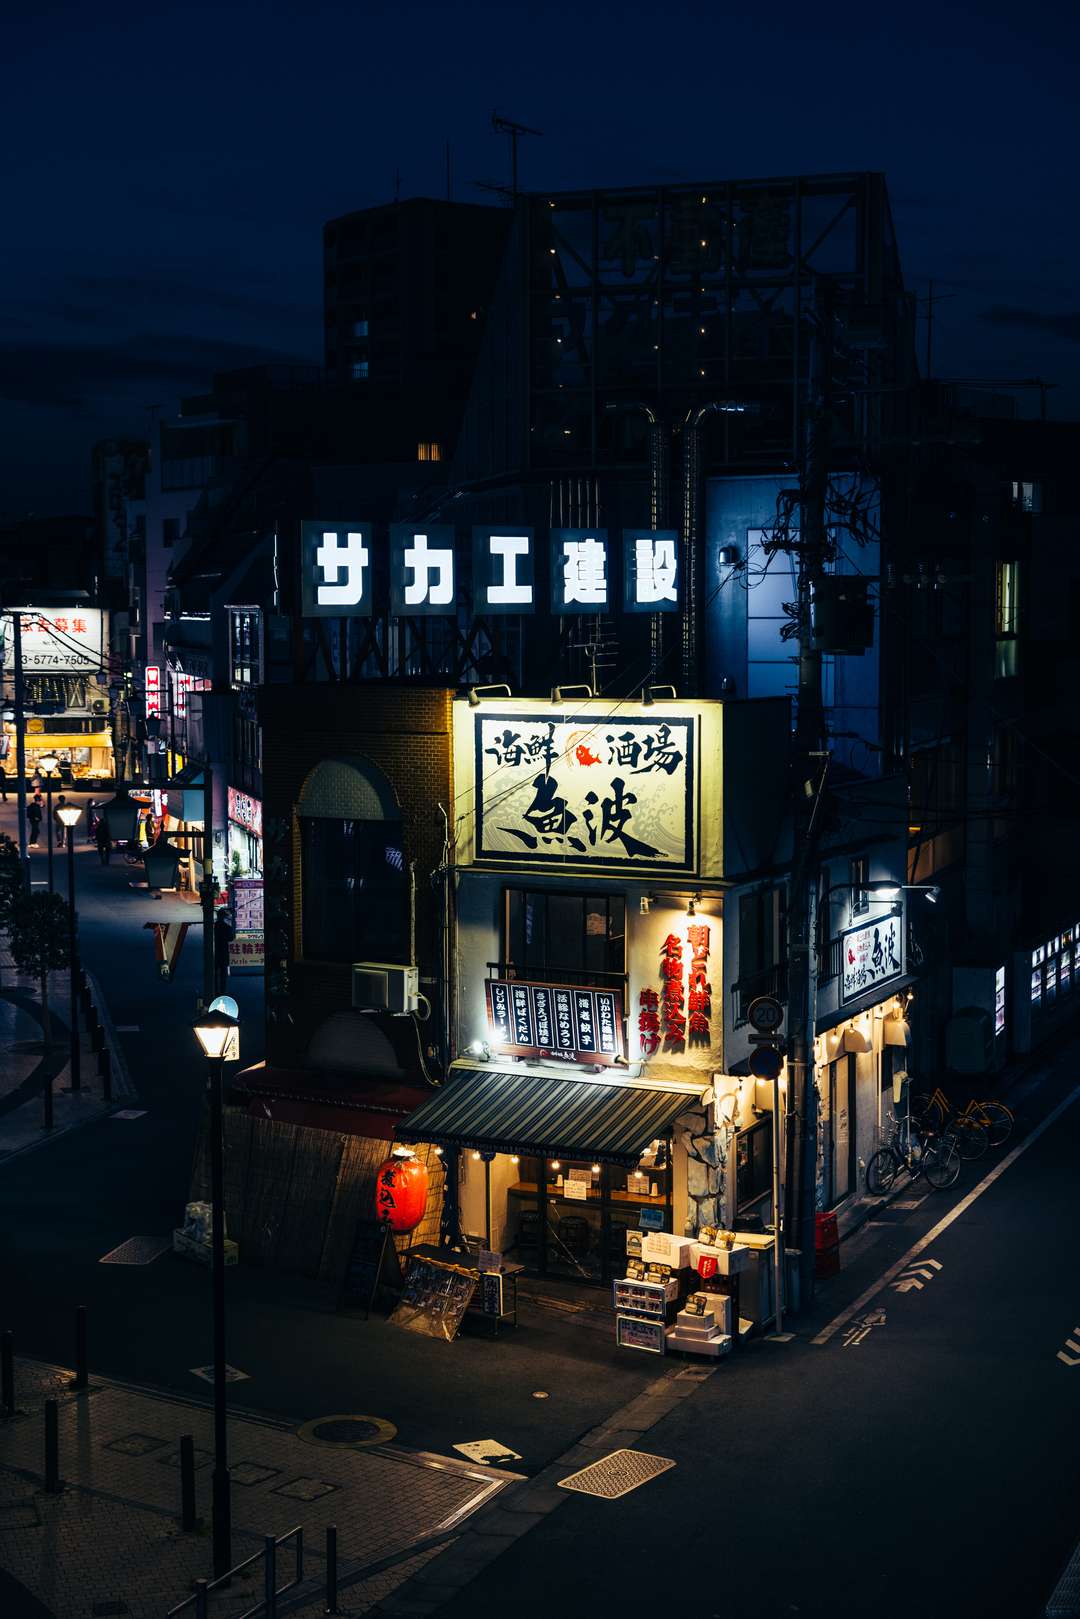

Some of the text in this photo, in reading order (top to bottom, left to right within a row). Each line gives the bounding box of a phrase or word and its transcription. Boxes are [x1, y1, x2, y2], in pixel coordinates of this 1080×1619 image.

[317, 532, 678, 605] サカエ建設
[21, 655, 90, 665] 3-5774-7505
[485, 722, 684, 782] 海鮮 酒場
[496, 774, 669, 858] 魚波
[756, 1007, 776, 1022] 20
